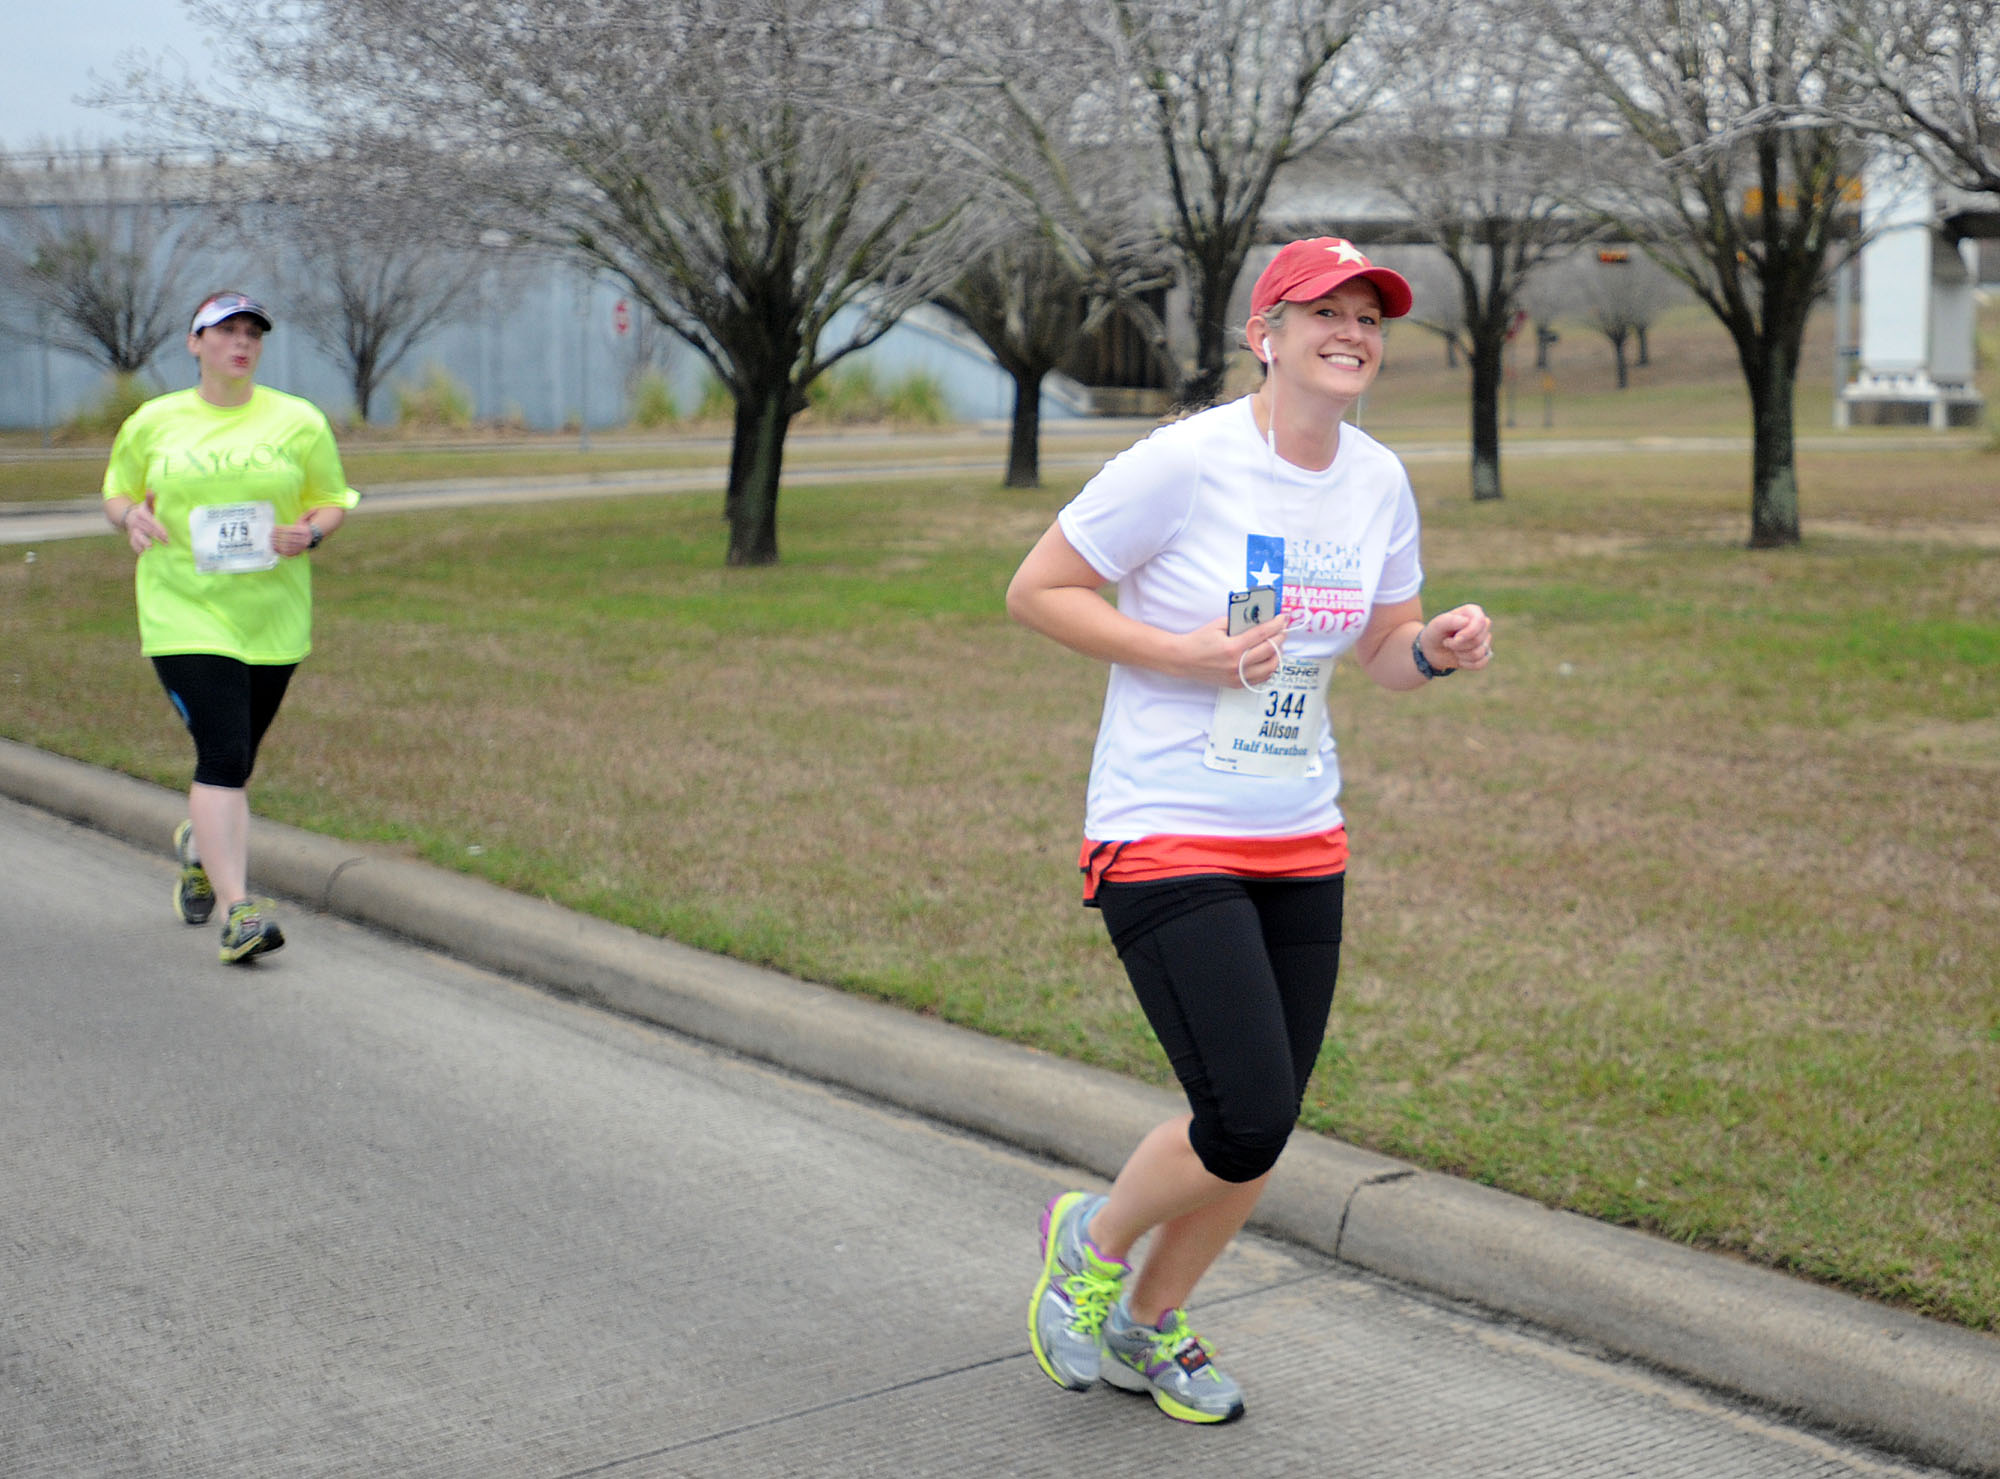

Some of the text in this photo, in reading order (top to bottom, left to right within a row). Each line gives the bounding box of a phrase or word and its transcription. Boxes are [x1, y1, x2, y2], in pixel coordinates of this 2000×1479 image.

[1265, 690, 1306, 719] 344
[1259, 721, 1299, 739] Alison
[1232, 738, 1308, 756] Half Marathon
